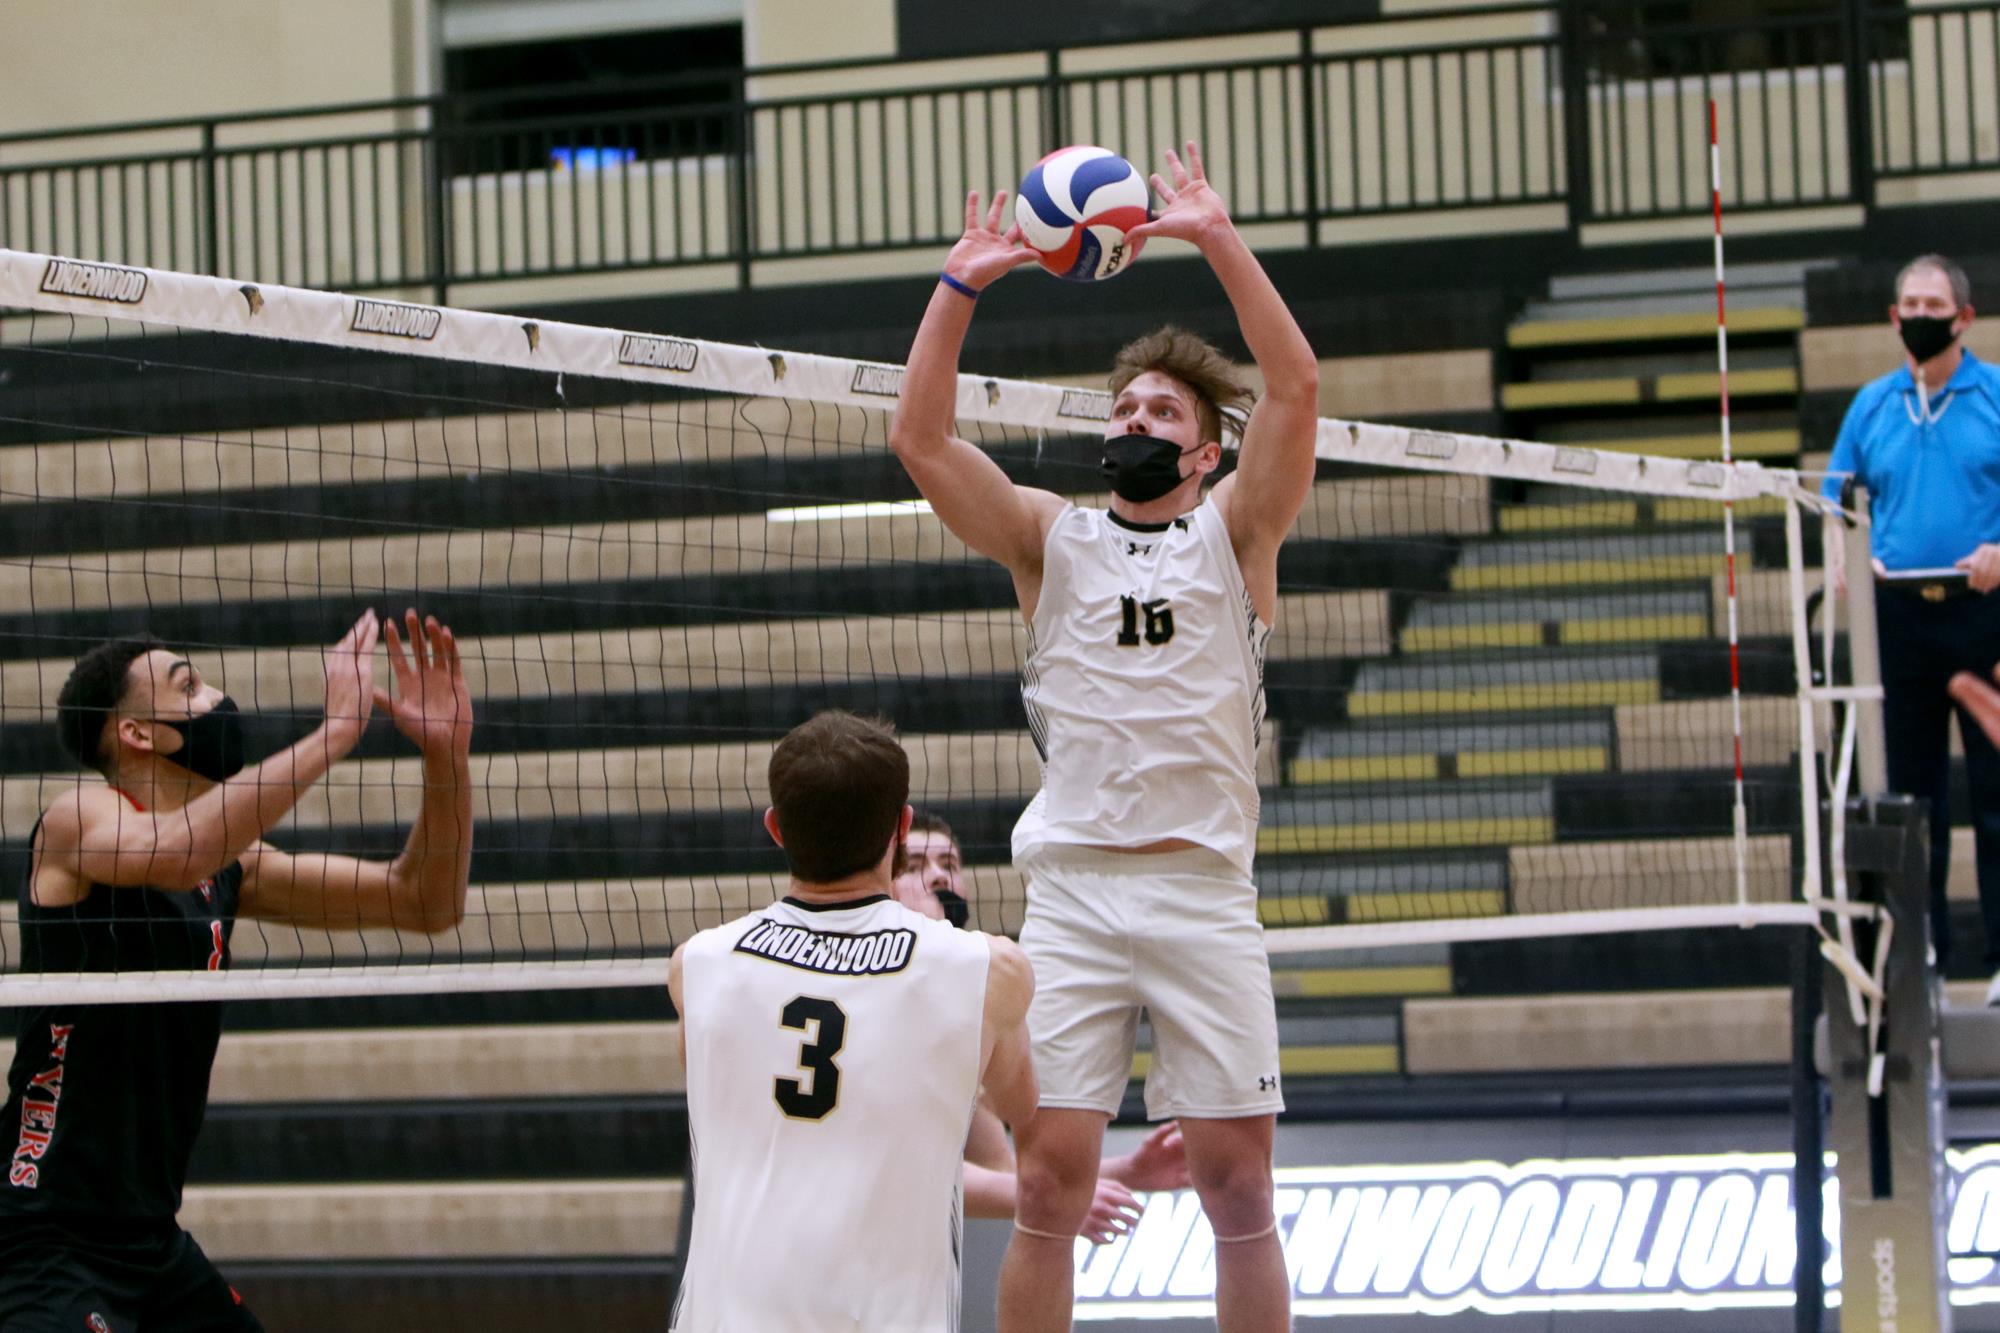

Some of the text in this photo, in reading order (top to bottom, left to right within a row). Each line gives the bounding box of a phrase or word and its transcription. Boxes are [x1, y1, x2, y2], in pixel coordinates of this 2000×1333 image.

[40, 259, 148, 304] LINDENWOOD
[351, 299, 442, 341] LINDENWOOD
[618, 334, 699, 373] LINDENWOOD
[1116, 594, 1175, 646] 16
[733, 918, 917, 976] LINDENWOOD
[772, 994, 849, 1123] 3
